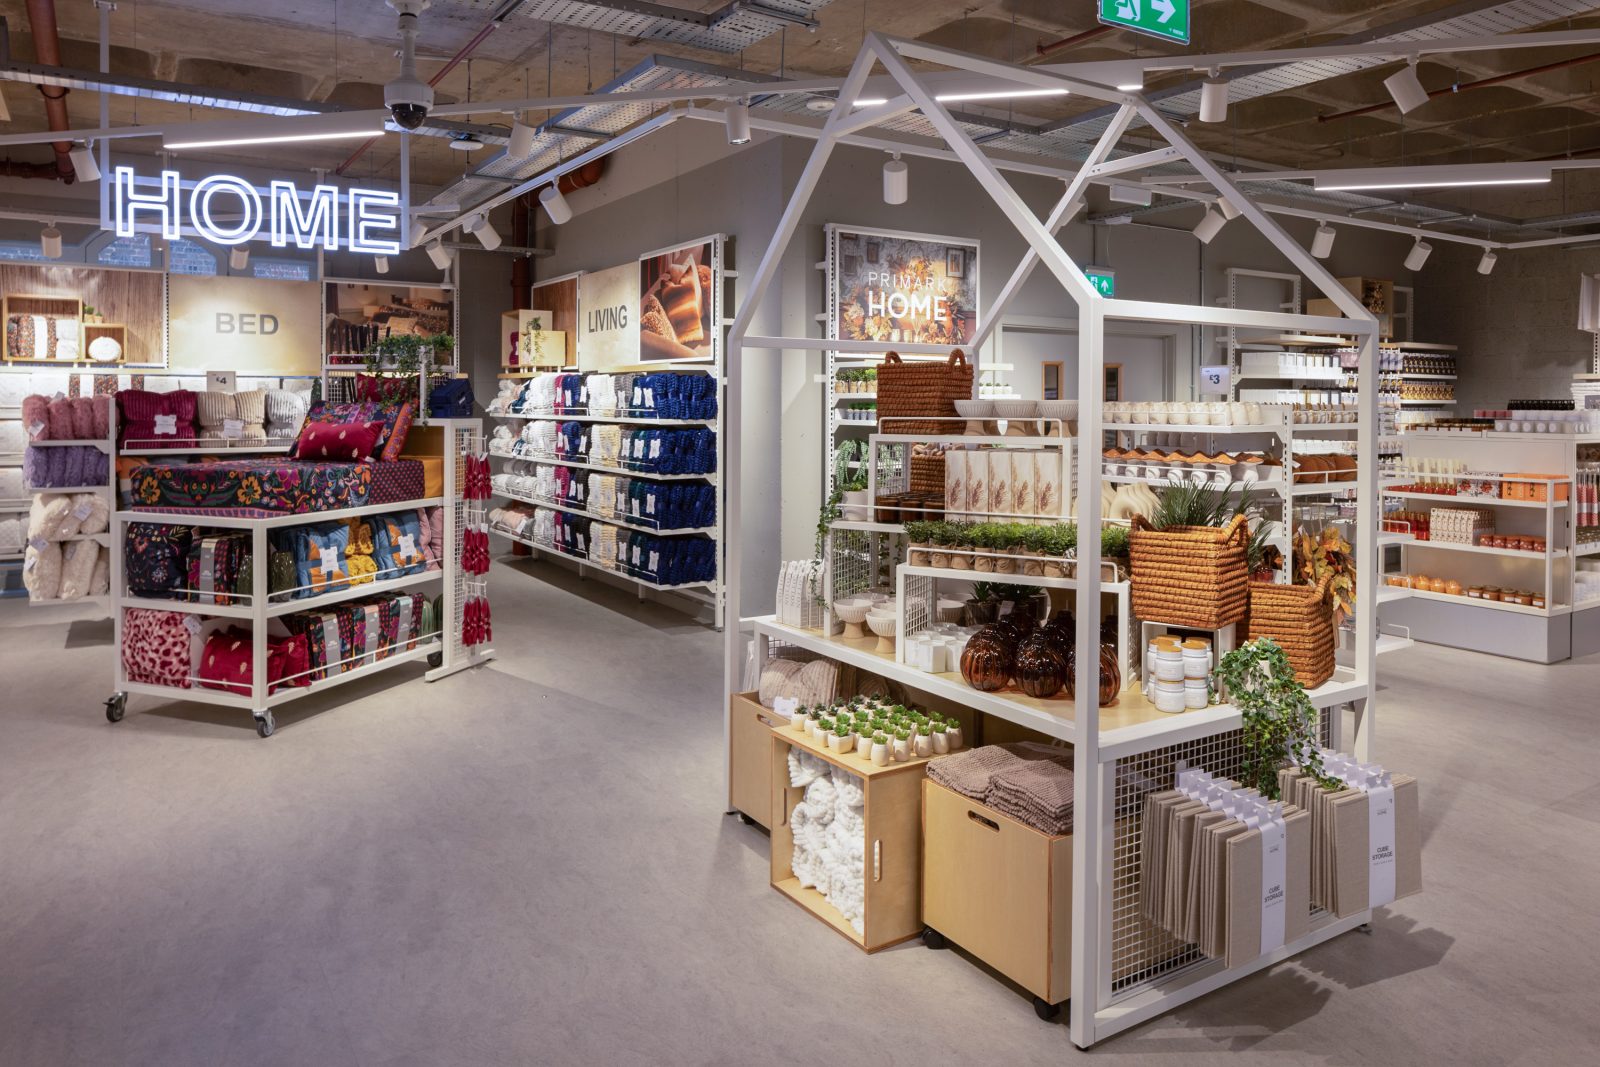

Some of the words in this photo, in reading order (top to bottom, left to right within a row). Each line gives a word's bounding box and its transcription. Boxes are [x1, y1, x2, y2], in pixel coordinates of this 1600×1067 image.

[114, 165, 401, 256] HOME
[868, 271, 947, 292] PRIMARK
[868, 291, 947, 321] HOME
[215, 312, 279, 335] BED
[588, 304, 628, 333] LIVING
[1209, 374, 1220, 385] £3
[1372, 851, 1393, 861] STORAGE
[1264, 890, 1284, 903] STORAGE
